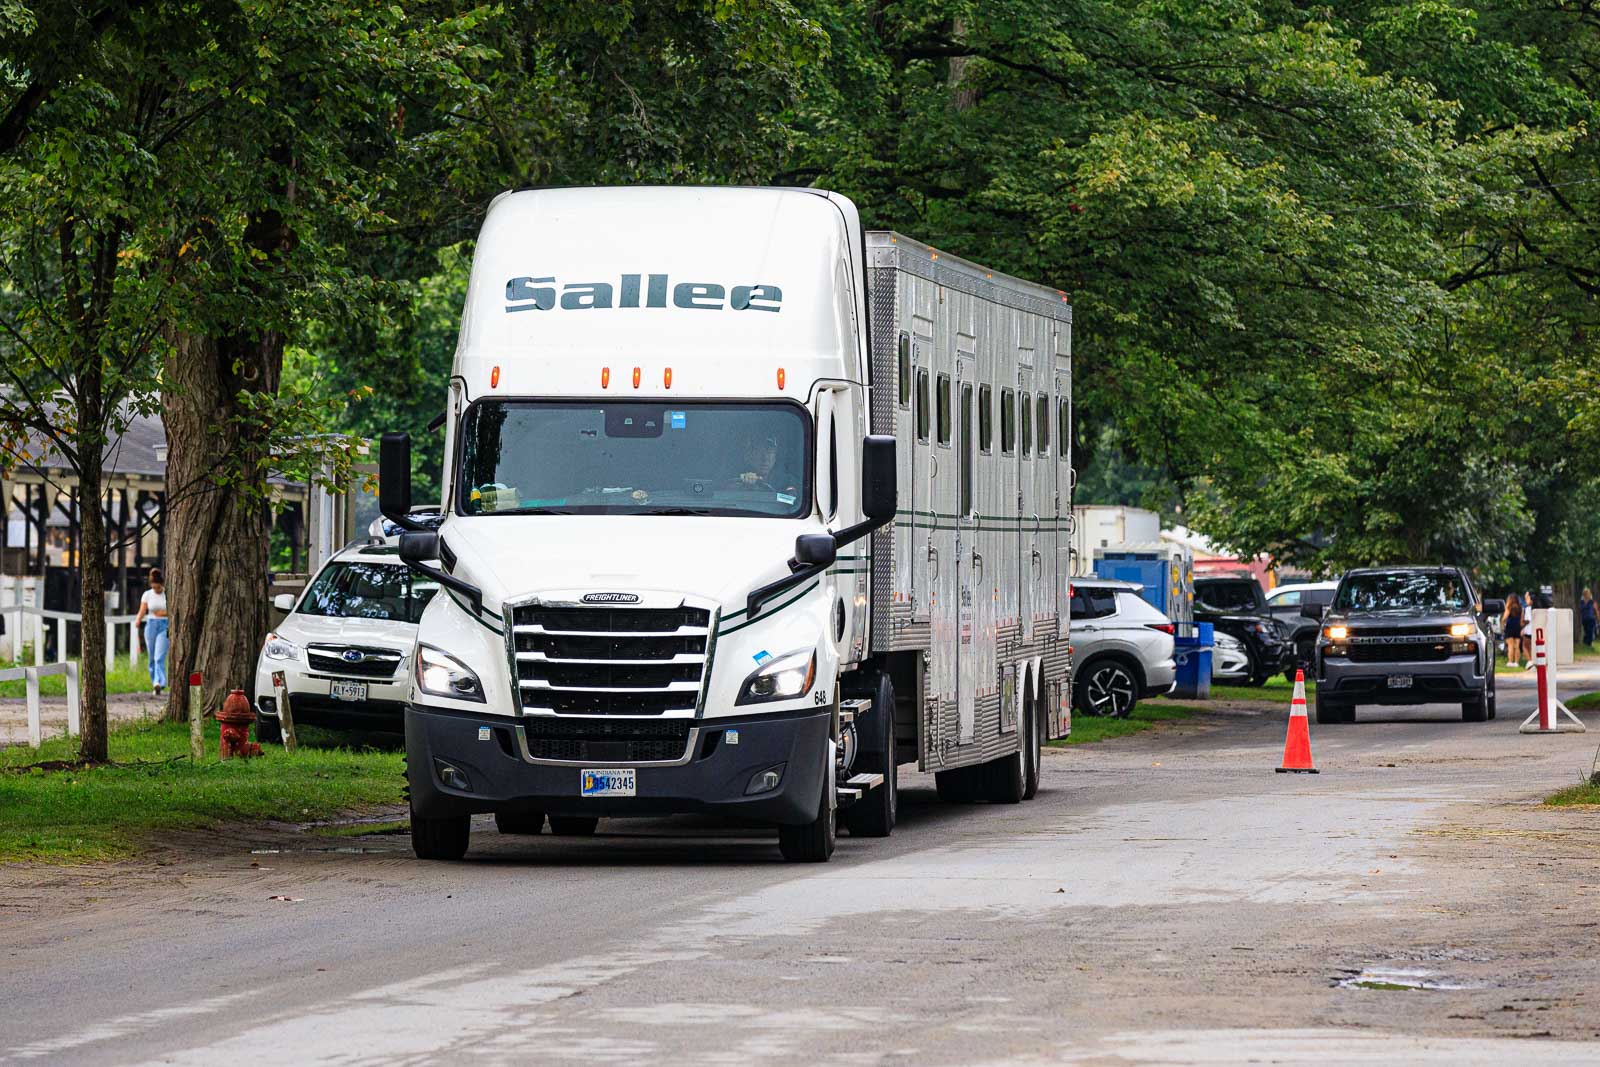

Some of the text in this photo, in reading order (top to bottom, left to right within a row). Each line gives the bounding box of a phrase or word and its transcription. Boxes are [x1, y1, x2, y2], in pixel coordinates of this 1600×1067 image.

[504, 273, 783, 313] Sallee
[585, 593, 637, 601] FREIGHTLINER
[814, 690, 827, 705] 648
